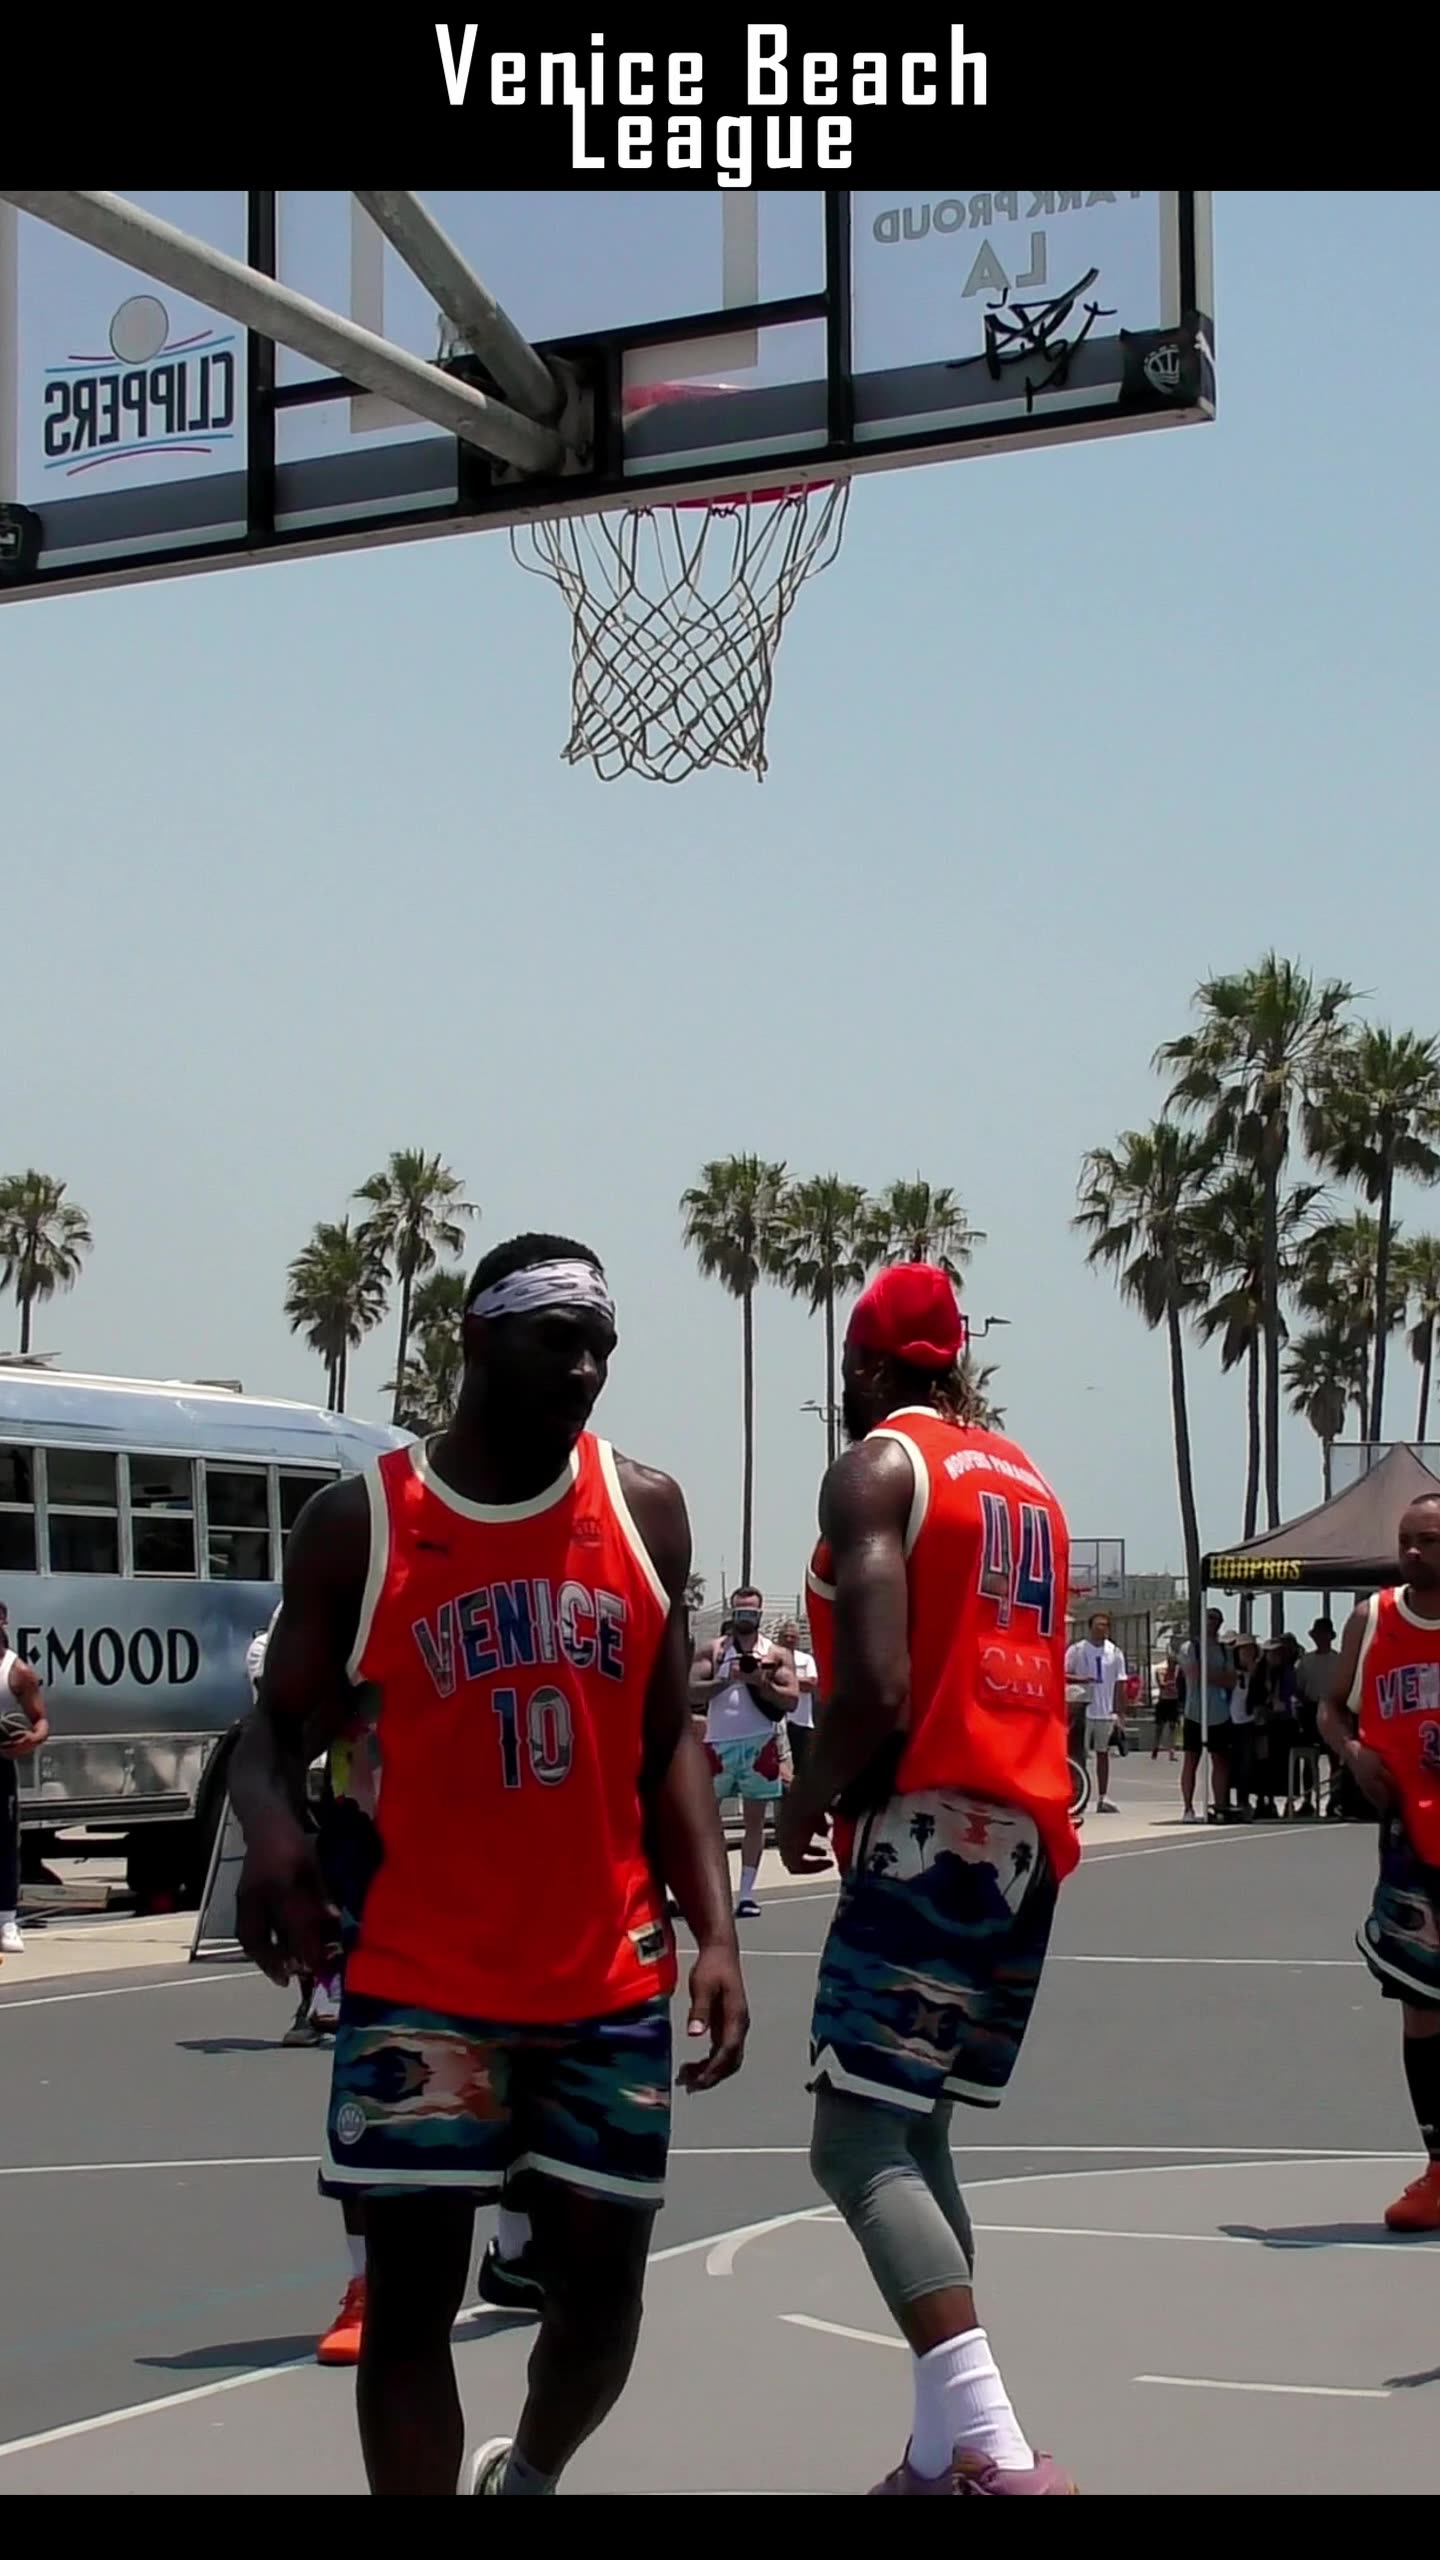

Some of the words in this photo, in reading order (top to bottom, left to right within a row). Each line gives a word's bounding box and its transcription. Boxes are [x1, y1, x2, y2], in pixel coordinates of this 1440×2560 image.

[977, 1491, 1055, 1637] 44
[411, 1578, 626, 1698] VENICE
[491, 1684, 573, 1788] 10
